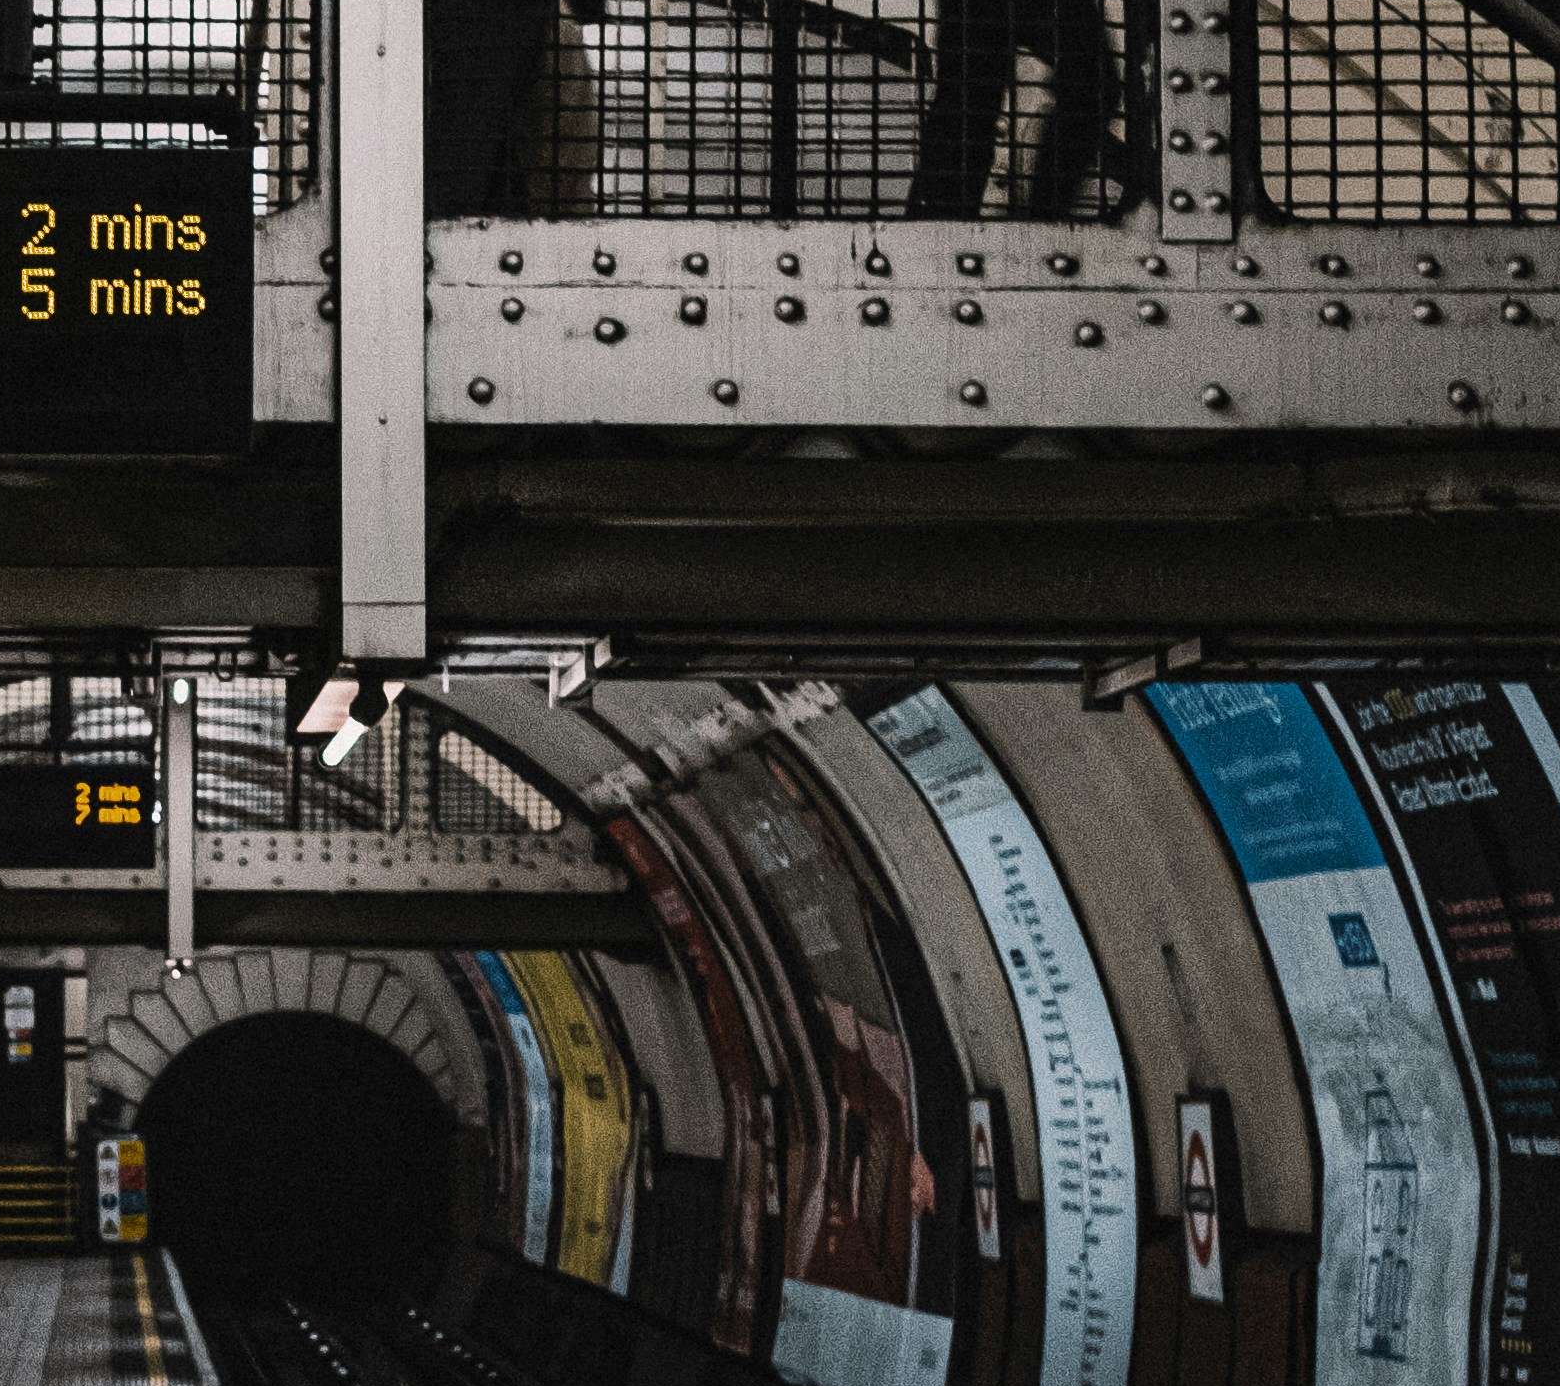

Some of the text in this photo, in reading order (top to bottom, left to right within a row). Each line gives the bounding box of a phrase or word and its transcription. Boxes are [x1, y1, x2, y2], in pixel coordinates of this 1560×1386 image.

[21, 202, 56, 256] 2
[90, 203, 207, 252] mins
[20, 267, 56, 320] 5
[89, 268, 206, 316] mins
